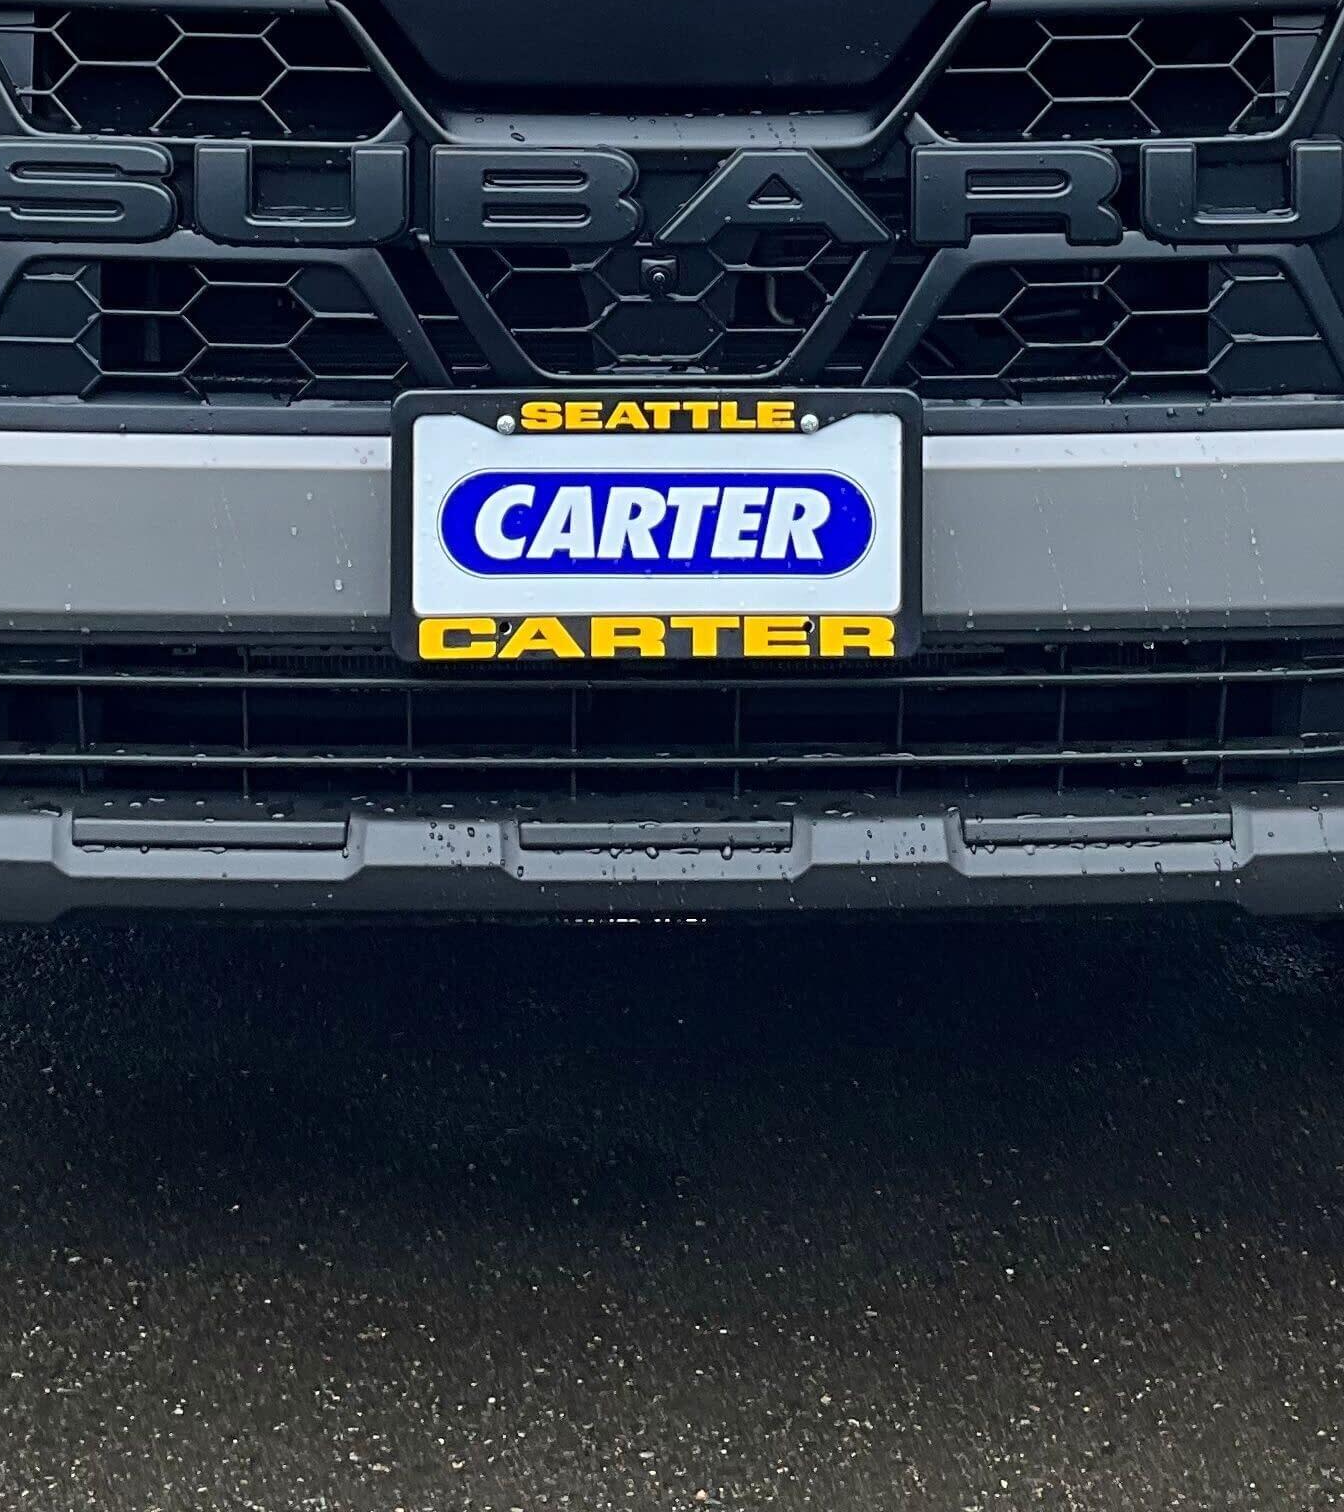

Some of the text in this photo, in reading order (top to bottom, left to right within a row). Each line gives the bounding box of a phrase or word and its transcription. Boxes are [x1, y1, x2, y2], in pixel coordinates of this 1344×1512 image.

[520, 400, 795, 431] SEATTLE
[474, 483, 831, 561] CARTER
[418, 616, 896, 660] CARTER
